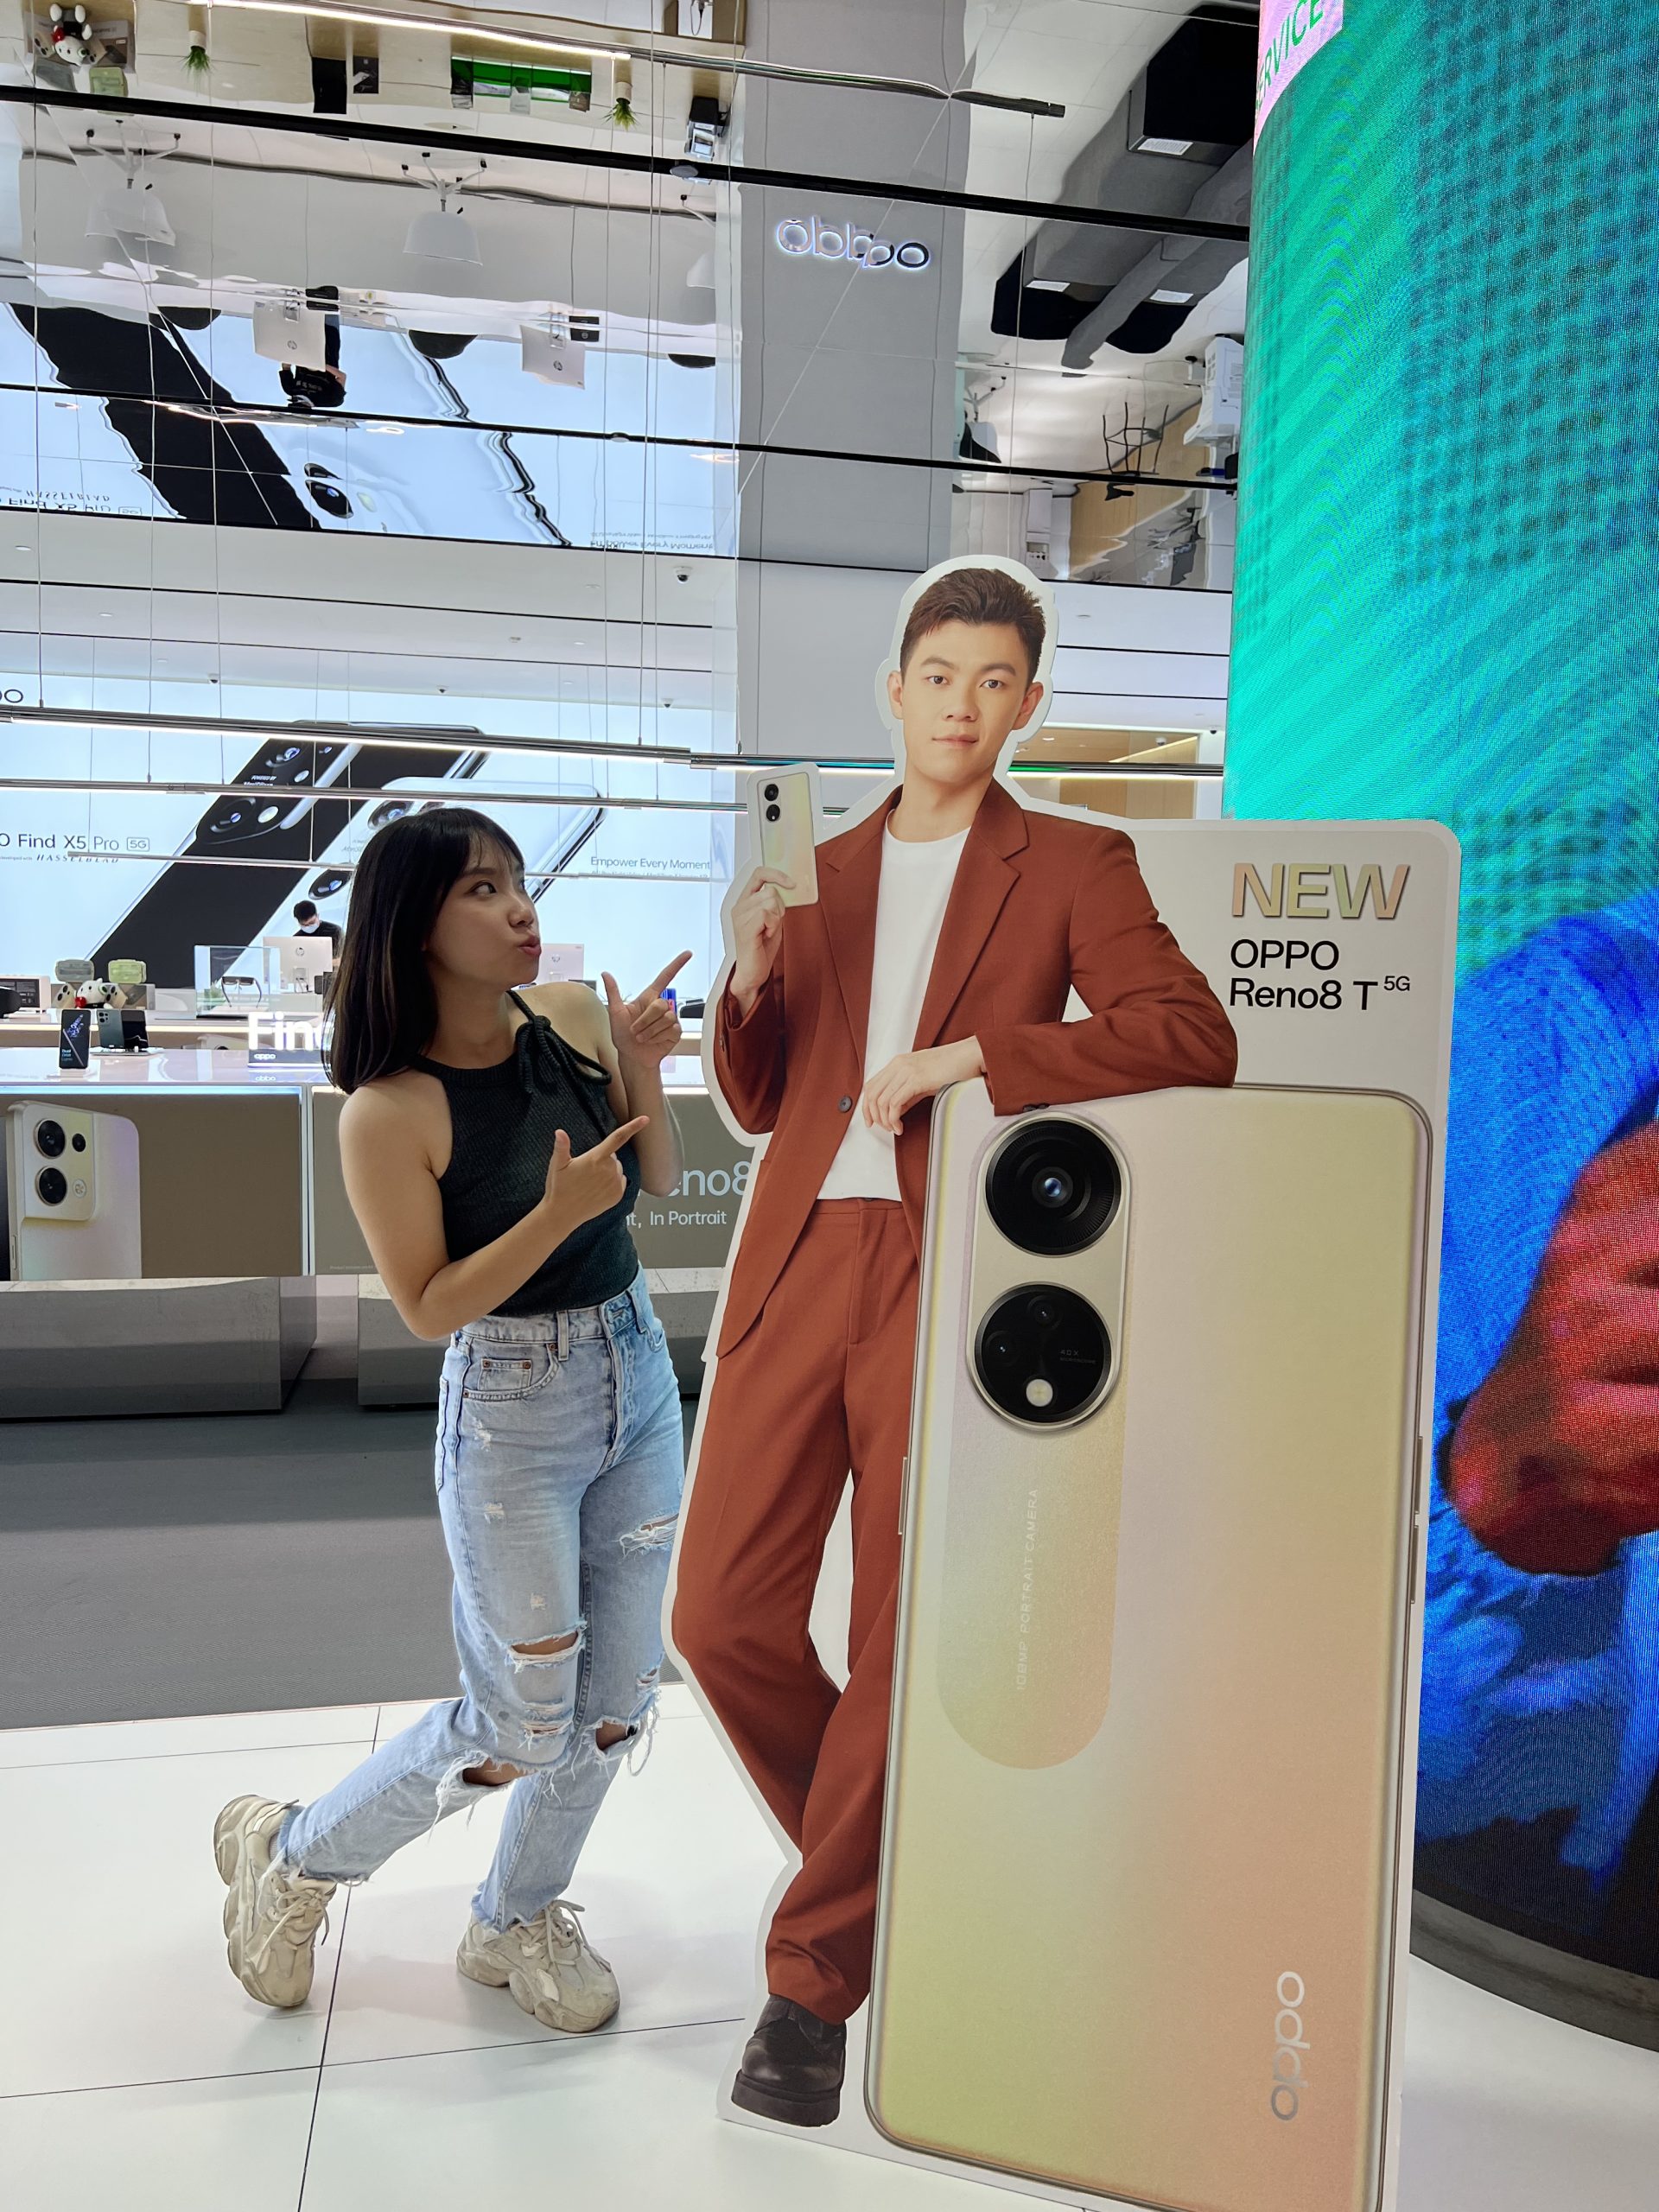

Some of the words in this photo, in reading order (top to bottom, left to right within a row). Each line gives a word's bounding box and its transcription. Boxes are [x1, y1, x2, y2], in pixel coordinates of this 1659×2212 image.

[18, 834, 56, 849] Find
[63, 835, 86, 849] X5
[93, 836, 119, 851] Pro
[129, 839, 147, 849] 5G
[591, 856, 638, 868] Empower
[639, 858, 668, 869] Every
[670, 859, 711, 869] Moment
[1231, 862, 1410, 919] NEW
[1230, 938, 1339, 970] OPPO
[1230, 977, 1342, 1010] Reno8
[1353, 981, 1378, 1010] T
[1383, 976, 1410, 991] 5G
[667, 1160, 752, 1197] no8
[650, 1211, 664, 1225] In
[669, 1210, 727, 1225] Portrait
[1025, 1489, 1039, 1552] CAMERA
[1020, 1558, 1034, 1633] PORTRAIT
[1271, 1971, 1311, 2121] oppo
